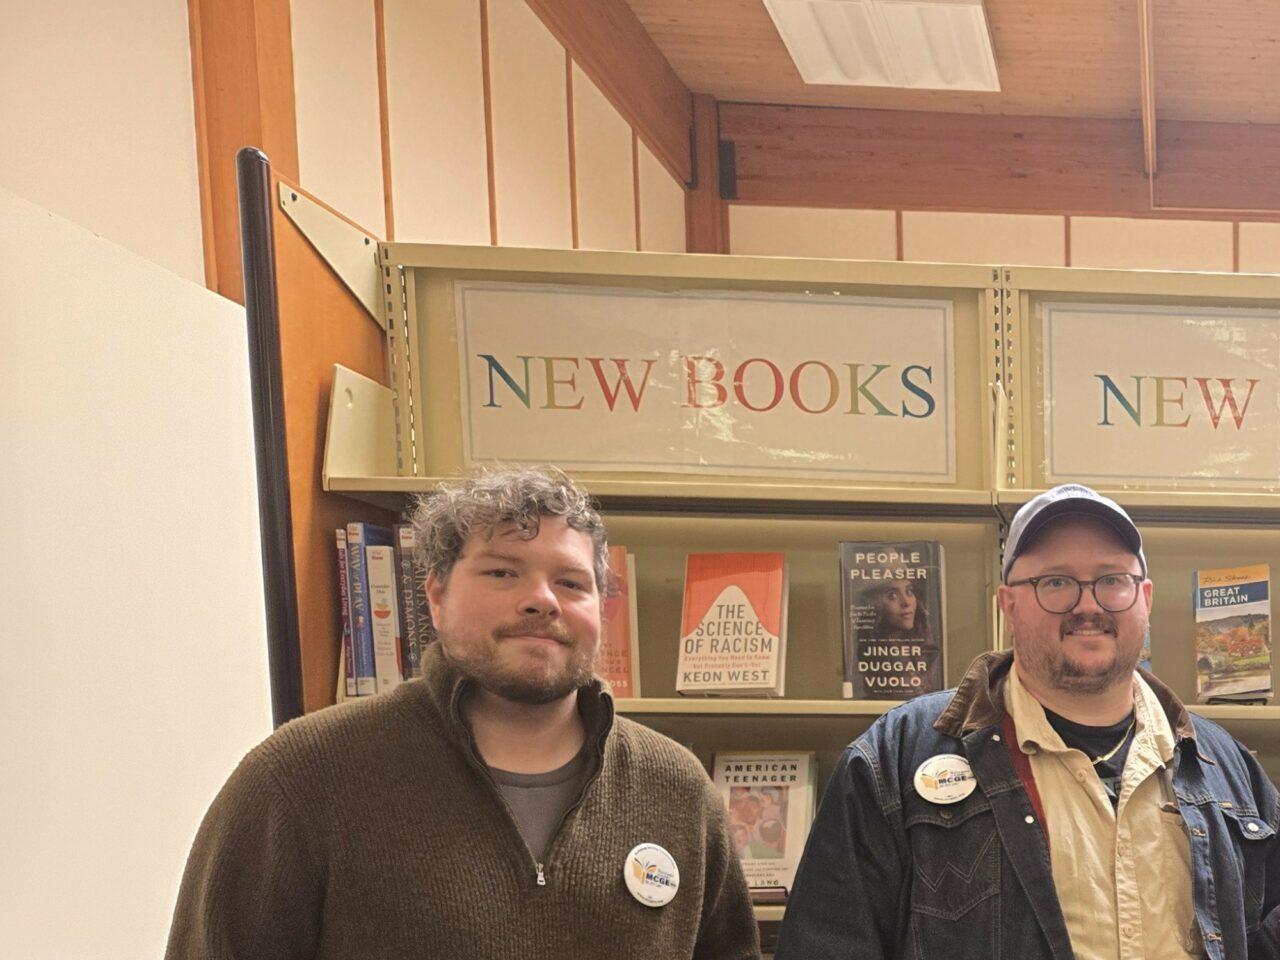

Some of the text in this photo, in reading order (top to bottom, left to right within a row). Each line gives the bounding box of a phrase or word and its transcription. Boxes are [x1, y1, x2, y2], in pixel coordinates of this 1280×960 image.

[476, 354, 937, 420] NEW BOOKS
[1094, 374, 1261, 431] NEW
[855, 552, 921, 564] PEOPLE
[851, 568, 927, 580] PLEASER
[1204, 586, 1240, 598] GREAT
[1204, 594, 1248, 607] BRITAIN
[717, 604, 746, 619] THE
[696, 620, 763, 637] SCIENCE
[685, 637, 773, 654] OF RACISM
[863, 646, 922, 657] JINGER
[858, 661, 927, 672] DUGGAR
[683, 670, 769, 683] KEON WEST
[865, 676, 921, 687] VUOLO
[725, 764, 798, 773] AMERICAN
[725, 775, 797, 783] TEENAGER
[646, 873, 671, 887] MCGE
